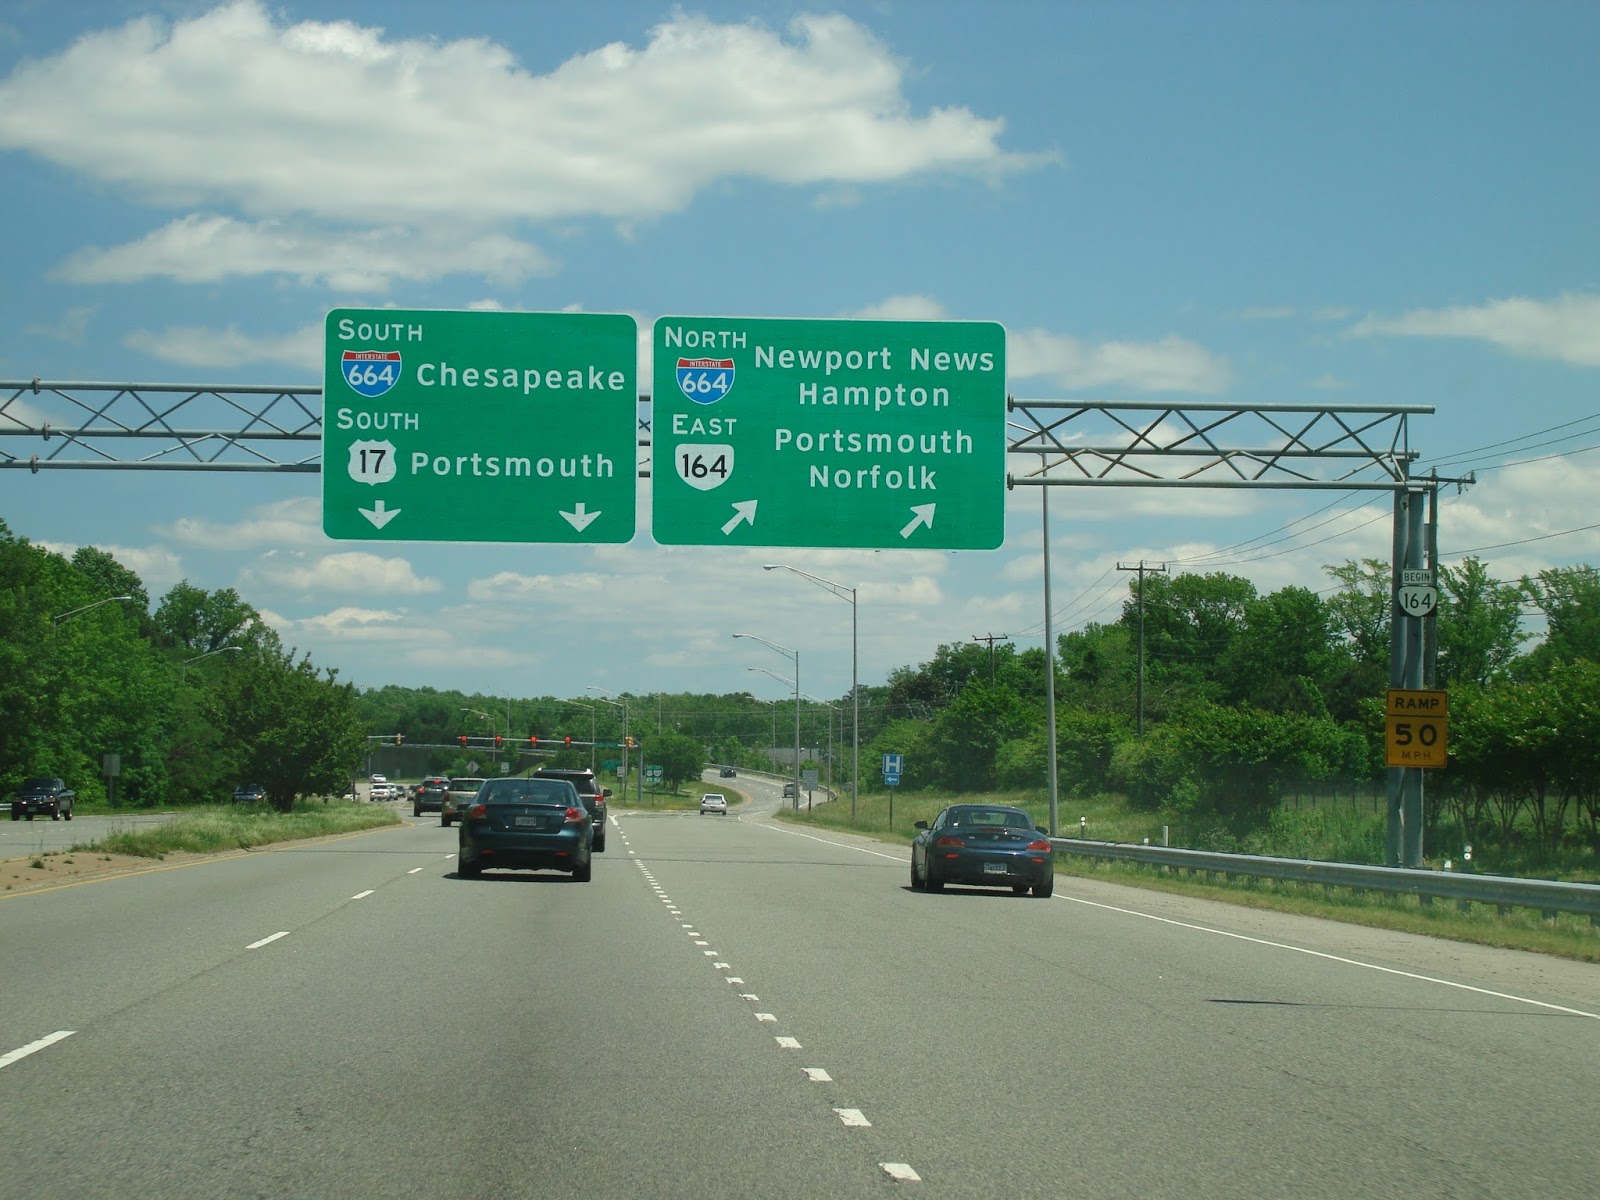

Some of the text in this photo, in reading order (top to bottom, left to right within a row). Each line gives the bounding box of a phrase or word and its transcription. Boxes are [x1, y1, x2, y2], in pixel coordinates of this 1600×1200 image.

[338, 319, 423, 342] SOUTH
[665, 326, 747, 349] NORTH
[355, 352, 388, 361] INTERSTATE
[689, 360, 721, 368] INTERSTATE
[755, 345, 994, 375] Newport News
[349, 364, 394, 386] 664
[416, 362, 625, 394] Chesapeake
[682, 372, 728, 394] 664
[799, 383, 950, 411] Hampton
[336, 407, 419, 430] SOUTH
[672, 414, 737, 436] EAST
[775, 428, 973, 454] Portsmouth
[359, 449, 386, 474] 17
[411, 452, 613, 478] Portsmouth
[682, 453, 727, 478] 164
[809, 465, 937, 490] Norfolk
[1404, 572, 1430, 582] BEGIN
[1403, 592, 1431, 609] 164
[1395, 697, 1439, 709] RAMP
[1395, 723, 1437, 746] 50
[885, 755, 901, 773] H
